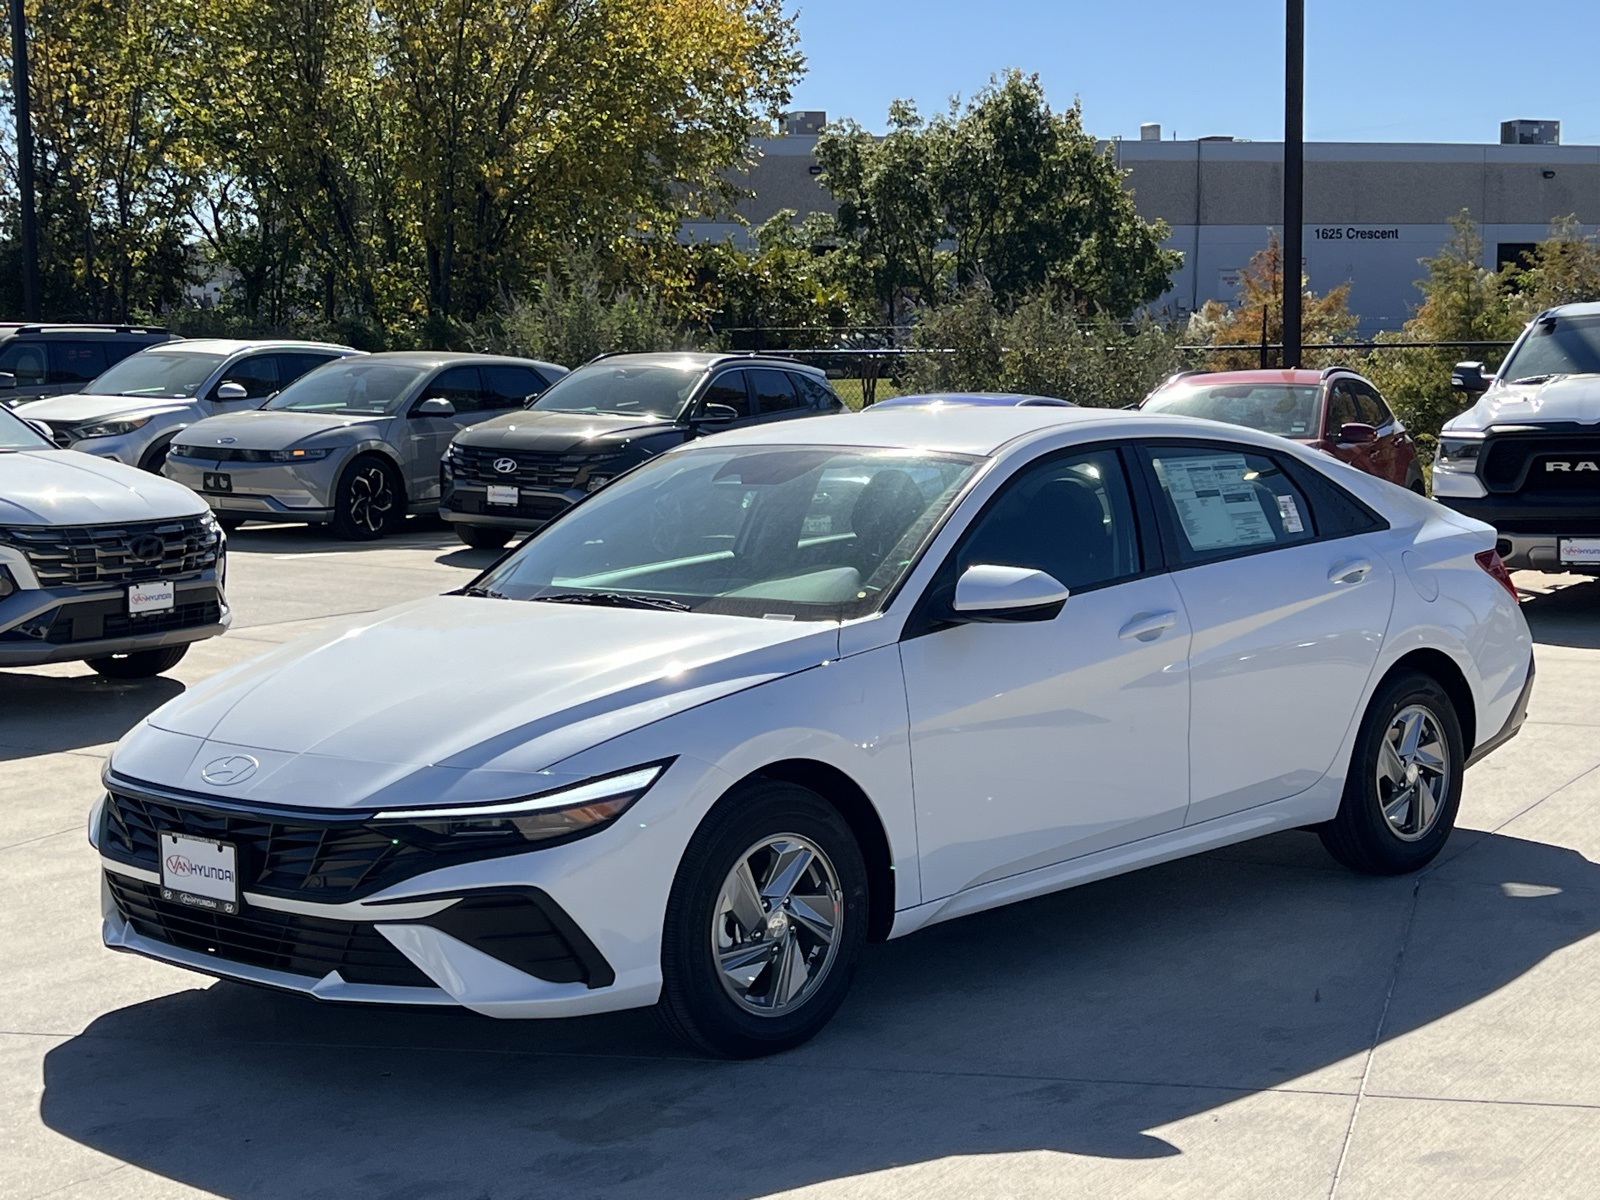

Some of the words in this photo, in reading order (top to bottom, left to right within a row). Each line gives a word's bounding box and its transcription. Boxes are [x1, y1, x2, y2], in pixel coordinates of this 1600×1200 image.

[1315, 228, 1343, 240] 1625
[1346, 227, 1399, 240] Crescent
[166, 854, 192, 878] VAN
[190, 862, 235, 883] HYUNDAI
